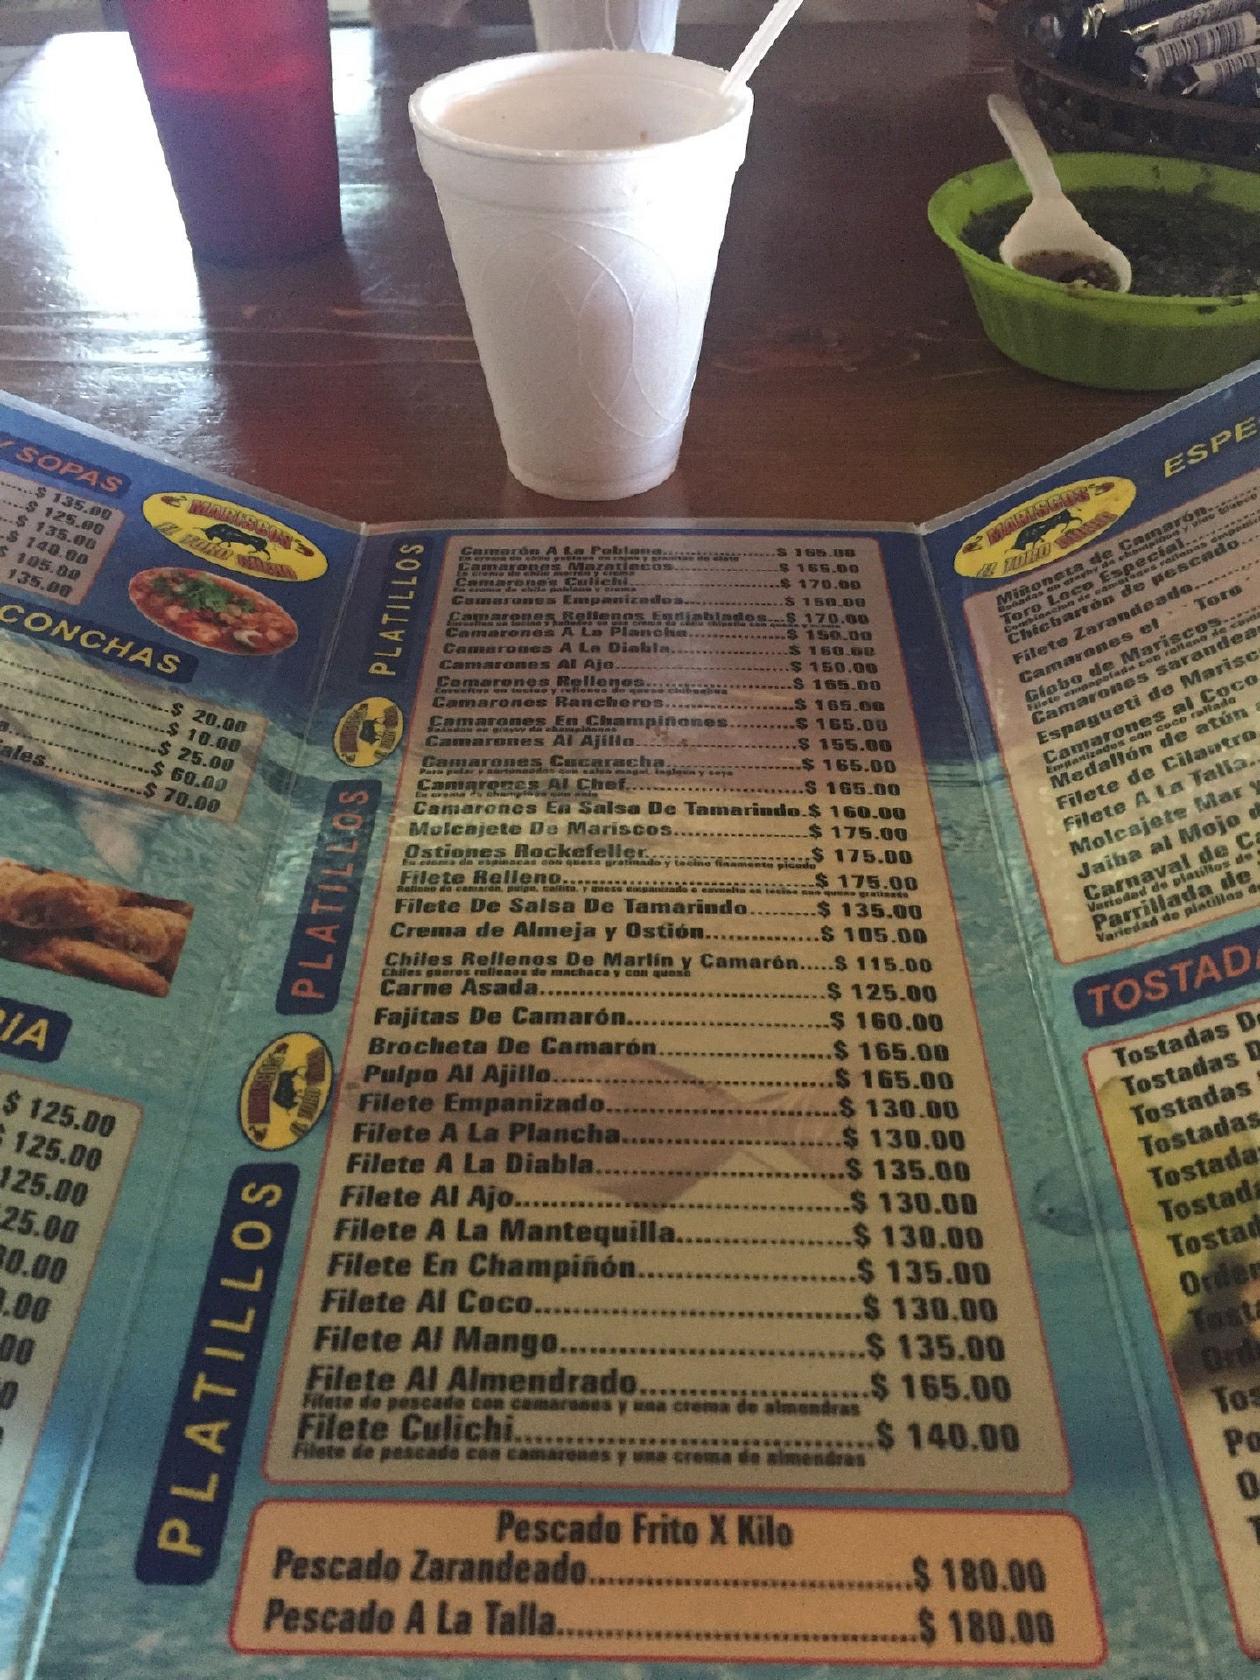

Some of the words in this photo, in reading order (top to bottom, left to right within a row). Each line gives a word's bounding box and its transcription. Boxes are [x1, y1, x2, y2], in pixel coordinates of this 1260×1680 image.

[16, 441, 122, 492] SOPAS
[368, 544, 424, 676] PLATILLOS
[450, 612, 555, 621] Camarones
[563, 611, 644, 620] Rellenos
[446, 628, 554, 637] Camarones
[562, 627, 573, 636] A
[582, 627, 602, 636] La
[610, 627, 687, 638] Plancha
[1012, 635, 1068, 665] Filete
[1074, 583, 1193, 640] Zarandeado
[1019, 632, 1133, 683] Camarones
[1139, 618, 1159, 635] el
[1194, 584, 1242, 612] Toro
[0, 605, 181, 674] CONCHAS
[443, 643, 552, 654] Camarones
[560, 643, 572, 653] A
[579, 643, 600, 653] La
[609, 643, 669, 653] Diabla
[440, 660, 550, 670] Camarones
[557, 660, 577, 669] Al
[584, 659, 614, 671] Ajo
[437, 676, 549, 687] Camarones
[557, 676, 644, 687] Rellenos
[432, 697, 547, 708] Camarones
[556, 697, 663, 708] Rancheros
[193, 709, 247, 733] 20.00
[430, 715, 546, 726] Camarones
[555, 715, 578, 726] En
[586, 715, 728, 728] Champiñones
[816, 718, 888, 731] 165.00
[425, 735, 544, 746] Camarones
[553, 735, 572, 746] Al
[581, 735, 635, 749] Ajillo
[819, 739, 891, 752] 155.00
[1050, 743, 1153, 789] Medallón
[1160, 730, 1187, 748] de
[1195, 708, 1248, 735] atún
[178, 748, 235, 771] 25.00
[422, 755, 542, 768] Camarones
[551, 755, 665, 767] Cucaracha
[1056, 780, 1119, 810] Filete
[1127, 767, 1155, 785] de
[1162, 729, 1257, 772] Cilantro
[171, 767, 228, 791] 60.00
[418, 778, 539, 791] Camarones
[550, 778, 568, 790] Al
[577, 778, 625, 790] Chef
[165, 787, 220, 813] 70.00
[414, 802, 537, 815] Camarones
[546, 801, 570, 814] En
[579, 801, 641, 814] Salsa
[649, 802, 676, 814] De
[684, 802, 800, 817] Tamarindo
[409, 822, 521, 837] Molcajete
[530, 822, 558, 835] De
[568, 822, 672, 836] Mariscos
[832, 826, 907, 841] 175.00
[405, 844, 506, 858] Ostiones
[515, 844, 646, 858] Rockefeller
[1077, 850, 1142, 879] Jaiba
[1151, 835, 1172, 855] al
[1178, 814, 1240, 844] Mojo
[401, 870, 464, 885] Filete
[474, 870, 561, 885] Relleno
[291, 790, 368, 1001] PLATILLOS
[395, 899, 460, 913] Filete
[471, 899, 500, 913] De
[509, 899, 575, 913] Salsa
[584, 899, 614, 914] De
[623, 898, 747, 915] Tamarindo
[390, 922, 466, 937] Crema
[476, 922, 504, 937] de
[513, 922, 596, 941] Almeja
[605, 926, 616, 941] y
[626, 922, 704, 939] Ostión
[385, 952, 453, 966] Chiles
[462, 952, 557, 966] Rellenos
[567, 952, 594, 966] De
[682, 956, 691, 969] y
[700, 954, 799, 970] Camarón
[381, 979, 452, 996] Carne
[462, 979, 537, 996] Asada
[852, 983, 937, 1002] 125.00
[374, 1007, 459, 1028] Fajitas
[470, 1007, 501, 1025] De
[513, 1007, 626, 1026] Camarón
[368, 1038, 487, 1055] Brocheta
[498, 1038, 529, 1055] De
[542, 1038, 656, 1056] Camarón
[1113, 1024, 1230, 1067] Tostadas
[364, 1065, 437, 1087] Pulpo
[447, 1064, 473, 1082] Al
[482, 1065, 551, 1087] Ajillo
[1121, 1052, 1240, 1096] Tostadas
[358, 1094, 434, 1112] Filete
[444, 1093, 605, 1116] Empanizado
[30, 1097, 116, 1137] 125.00
[353, 1123, 430, 1143] Filete
[440, 1123, 458, 1143] A
[469, 1123, 499, 1143] La
[509, 1123, 620, 1144] Plancha
[16, 1130, 102, 1171] 125.00
[347, 1154, 425, 1173] Filete
[435, 1154, 452, 1173] A
[464, 1154, 494, 1173] La
[506, 1154, 594, 1174] Diabla
[341, 1186, 420, 1207] Filete
[431, 1186, 458, 1206] Al
[467, 1186, 514, 1212] Ajo
[334, 1219, 417, 1242] Filete
[426, 1219, 445, 1241] A
[457, 1219, 488, 1242] La
[500, 1219, 676, 1247] Mantequilla
[328, 1252, 411, 1277] Filete
[424, 1252, 458, 1277] En
[469, 1252, 635, 1283] Champiñón
[320, 1289, 406, 1313] Filete
[416, 1289, 445, 1312] Al
[458, 1289, 532, 1313] Coco
[314, 1326, 401, 1352] Filete
[412, 1326, 443, 1352] Al
[453, 1327, 558, 1359] Mango
[899, 1335, 1005, 1361] 135.00
[157, 1182, 282, 1557] PLATILLOS
[306, 1366, 396, 1392] Filete
[406, 1366, 437, 1392] Al
[447, 1366, 637, 1395] Almendrado
[902, 1374, 1012, 1401] 165.00
[298, 1414, 389, 1442] Filete
[402, 1414, 513, 1442] Culichi
[908, 1424, 1019, 1450] 140.00
[497, 1510, 620, 1544] Pescado
[633, 1513, 698, 1545] Frito
[710, 1514, 726, 1545] X
[738, 1515, 793, 1547] Kilo
[273, 1546, 400, 1582] Pescado
[411, 1550, 586, 1585] Zarandeado
[942, 1559, 1046, 1593] 180.00
[264, 1599, 394, 1634] Pescado
[405, 1601, 425, 1634] A
[437, 1601, 472, 1635] La
[486, 1601, 556, 1636] Talla
[949, 1610, 1055, 1644] 180.00
